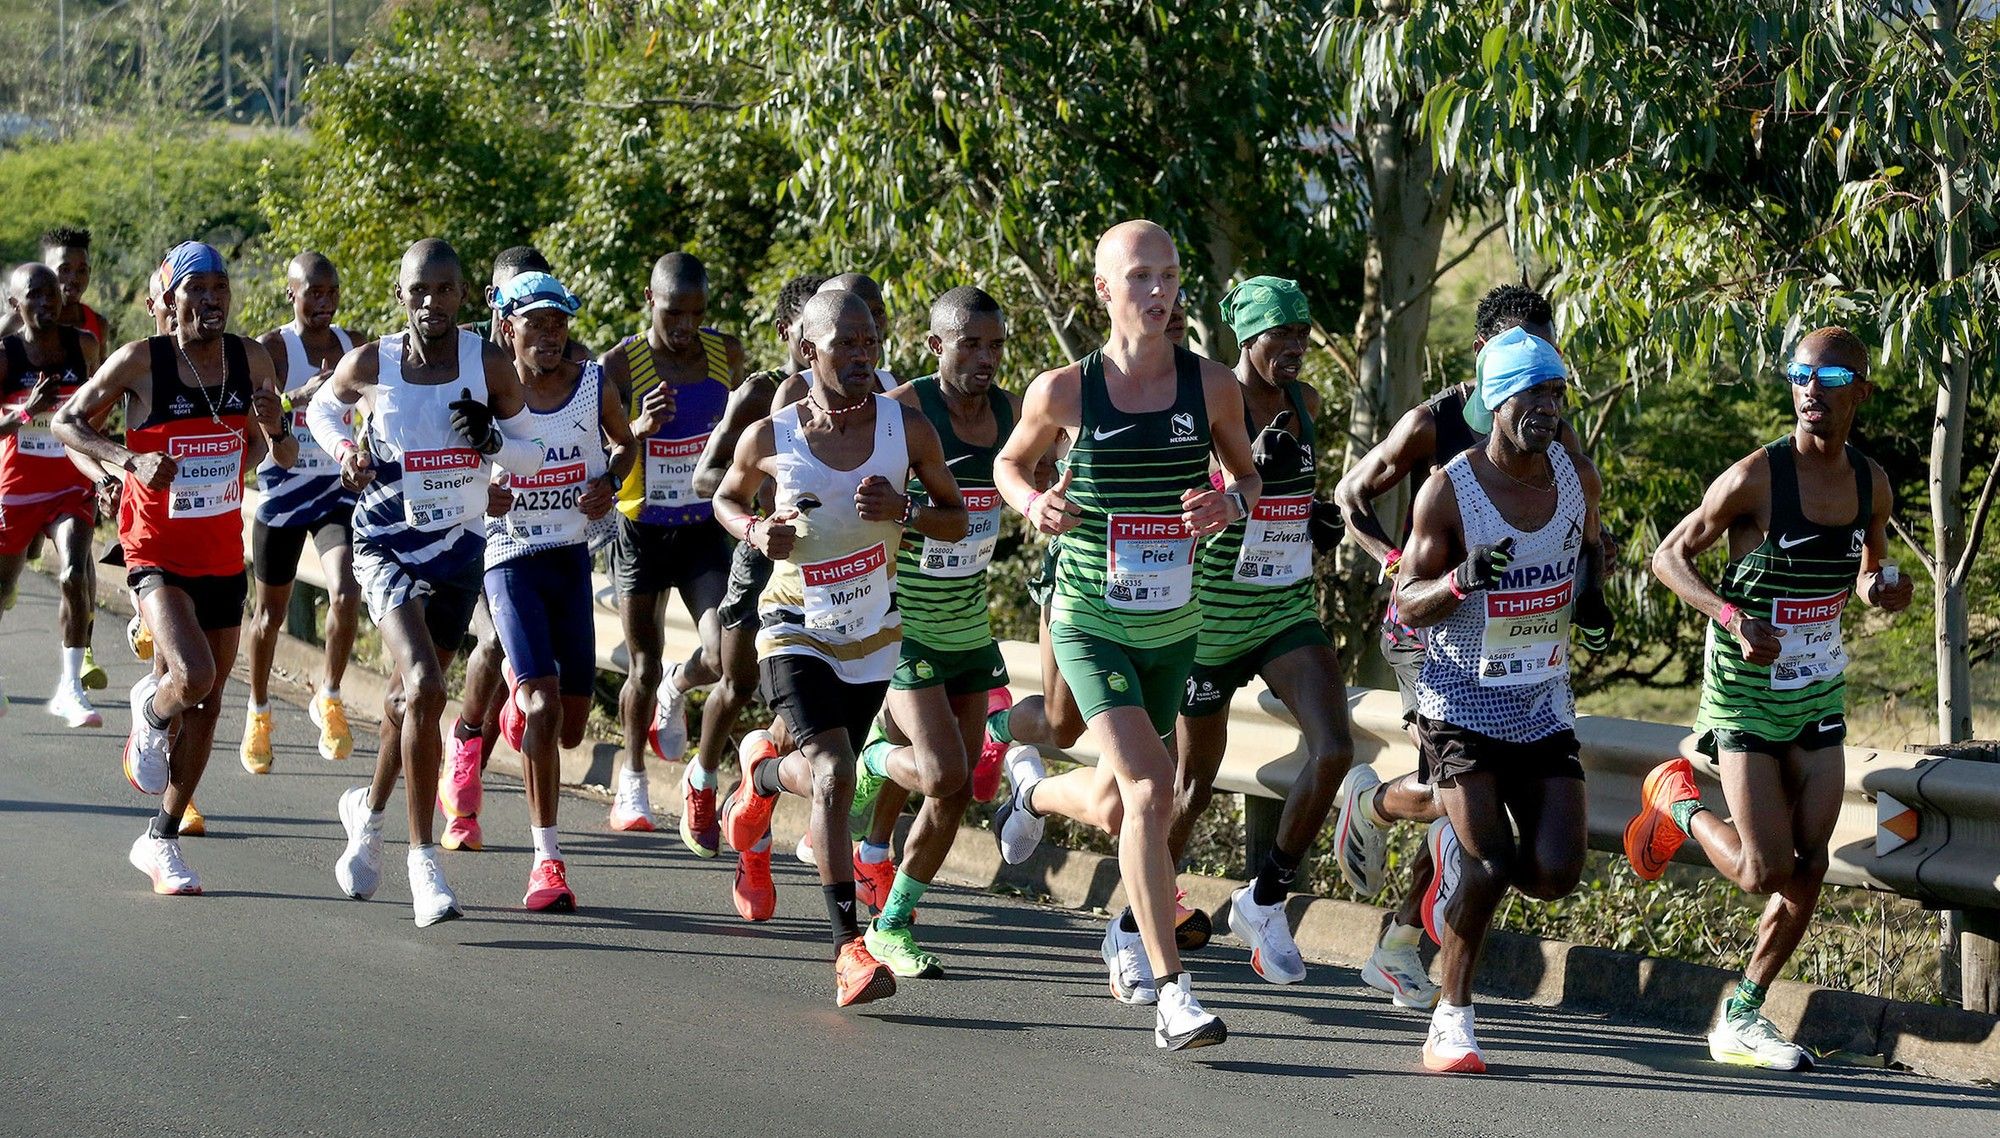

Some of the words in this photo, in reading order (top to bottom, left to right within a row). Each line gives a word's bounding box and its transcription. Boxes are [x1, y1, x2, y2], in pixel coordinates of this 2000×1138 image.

[177, 437, 238, 454] THIRSTI
[653, 440, 707, 455] THIRST
[410, 453, 476, 468] THIRSTI
[545, 446, 581, 462] ALA
[181, 462, 236, 478] Lebenya
[515, 469, 581, 485] THIRSTI
[423, 475, 474, 491] Sanele
[513, 485, 583, 512] A23260
[1258, 502, 1311, 516] THIRST
[1117, 523, 1191, 535] THIRST
[1262, 530, 1312, 543] Edwar
[1141, 549, 1175, 563] Piet
[809, 551, 881, 581] THIRSTI
[1501, 556, 1576, 590] MPALA
[830, 585, 872, 606] Mpho
[1494, 590, 1568, 613] THIRSTI
[1783, 599, 1844, 620] THIRST
[1509, 619, 1558, 637] David
[1486, 662, 1505, 671] ASA
[1526, 662, 1533, 671] 9
